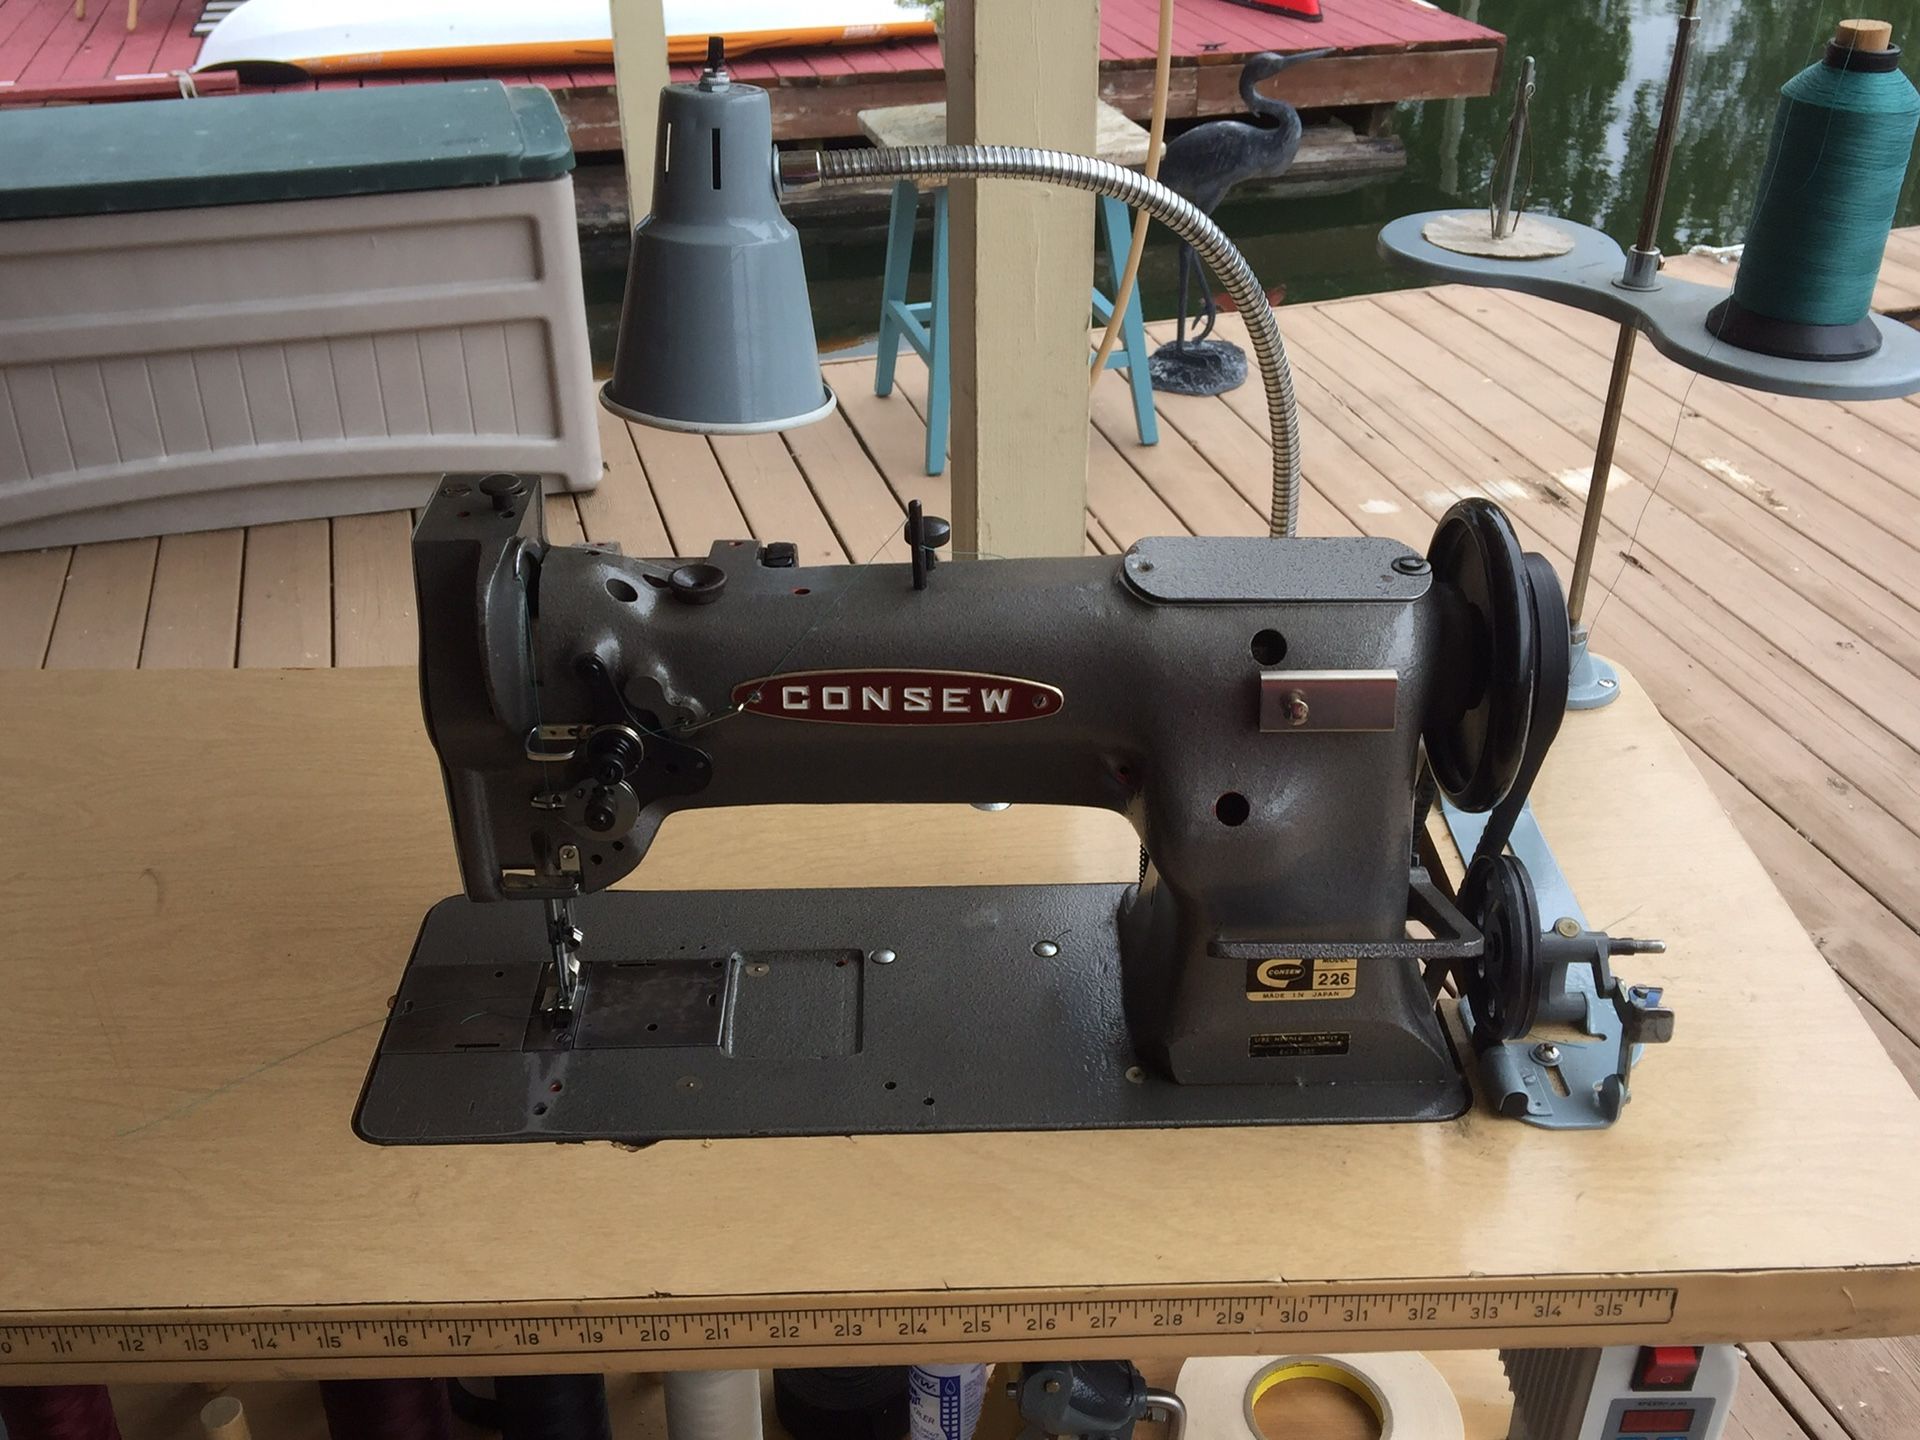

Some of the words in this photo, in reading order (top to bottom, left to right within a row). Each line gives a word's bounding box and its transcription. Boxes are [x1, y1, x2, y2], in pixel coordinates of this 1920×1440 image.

[782, 686, 1012, 713] CONSEW
[1318, 972, 1350, 986] 226
[52, 1341, 72, 1353] 11
[118, 1340, 144, 1352] 12
[185, 1339, 209, 1351] 13
[252, 1338, 277, 1349] 14
[317, 1337, 341, 1348] 15
[383, 1335, 408, 1347] 16
[448, 1335, 471, 1346] 17
[514, 1334, 539, 1345] 18
[578, 1332, 603, 1343] 19
[640, 1330, 670, 1341] 20
[705, 1329, 729, 1340] 21
[770, 1327, 799, 1338] 22
[835, 1324, 862, 1336] 23
[899, 1323, 928, 1335] 24
[963, 1321, 991, 1333] 25
[1027, 1319, 1056, 1330] 26
[1090, 1316, 1116, 1328] 27
[1154, 1314, 1182, 1326] 28
[1217, 1312, 1244, 1324] 29
[1280, 1311, 1308, 1323] 30
[1344, 1310, 1368, 1321] 31
[1408, 1308, 1436, 1320] 32
[1471, 1307, 1498, 1319] 33
[1534, 1306, 1561, 1318] 34
[1595, 1305, 1623, 1316] 35
